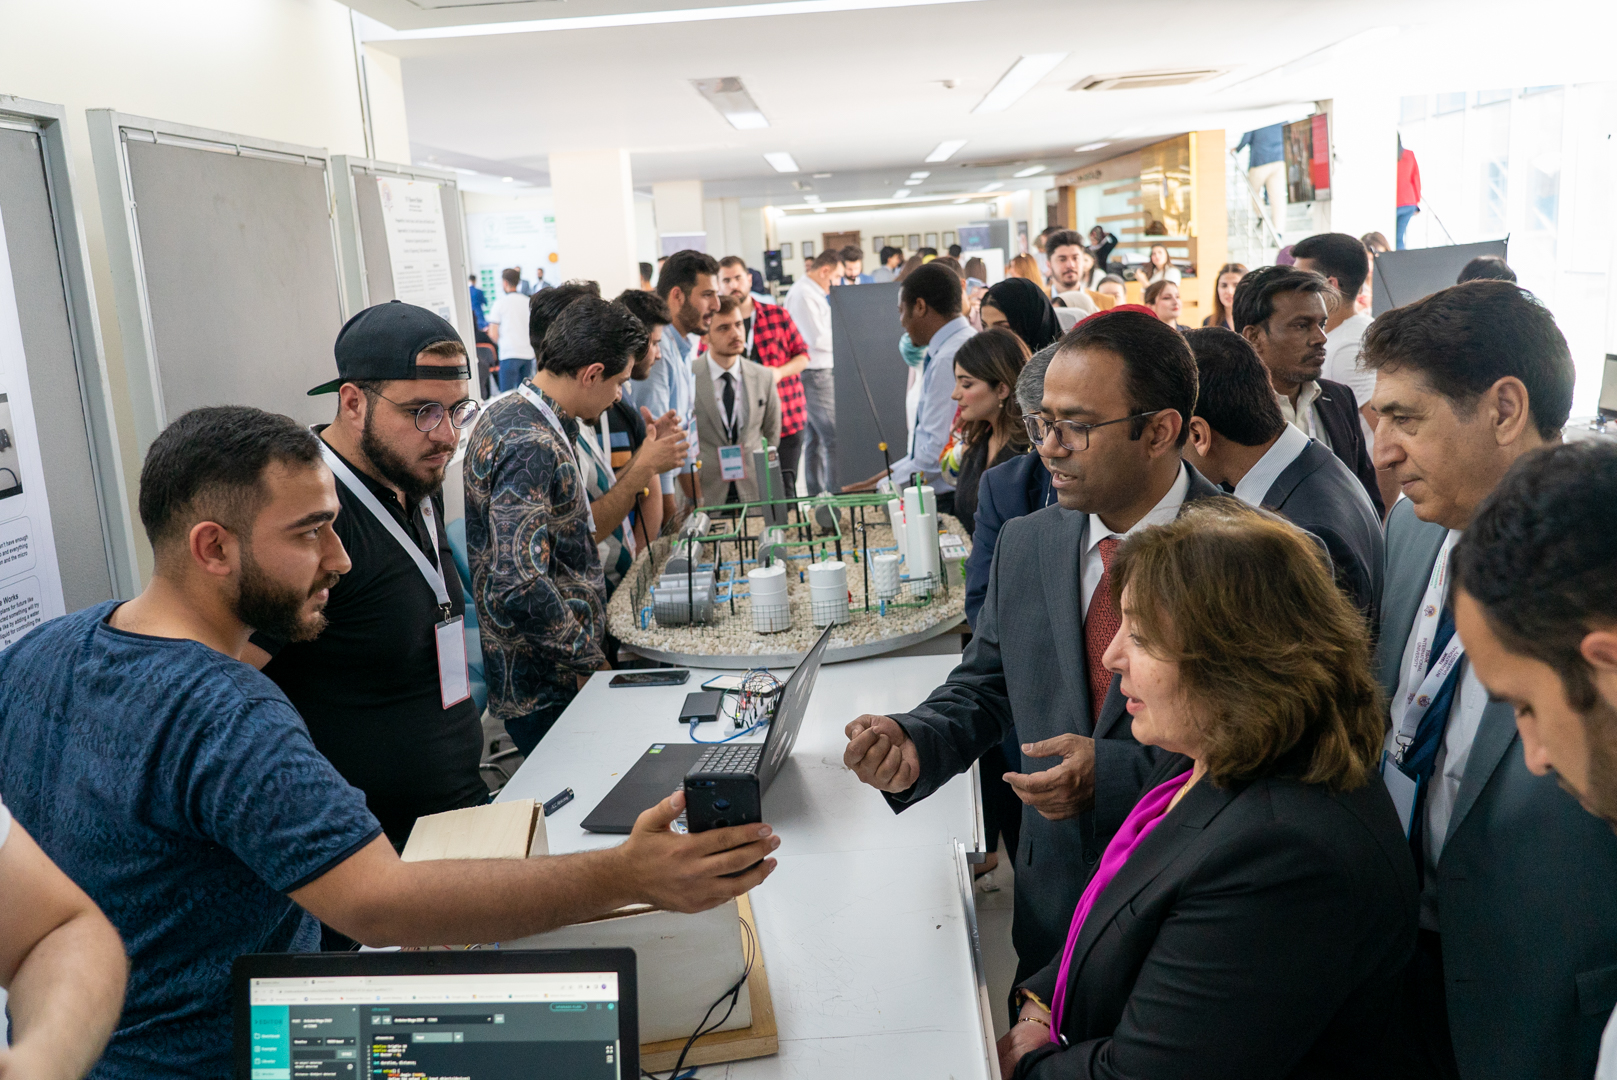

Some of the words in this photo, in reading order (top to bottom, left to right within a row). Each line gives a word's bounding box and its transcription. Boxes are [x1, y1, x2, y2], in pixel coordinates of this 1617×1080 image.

[15, 534, 28, 543] enough
[9, 543, 28, 553] everything
[3, 593, 19, 605] Works
[9, 608, 28, 619] something
[1413, 642, 1422, 668] UNIVERSITY
[1417, 637, 1428, 673] INTERNATIONAL
[1435, 645, 1459, 678] INTERNATIONAL
[1442, 651, 1460, 676] UNIVERSITY
